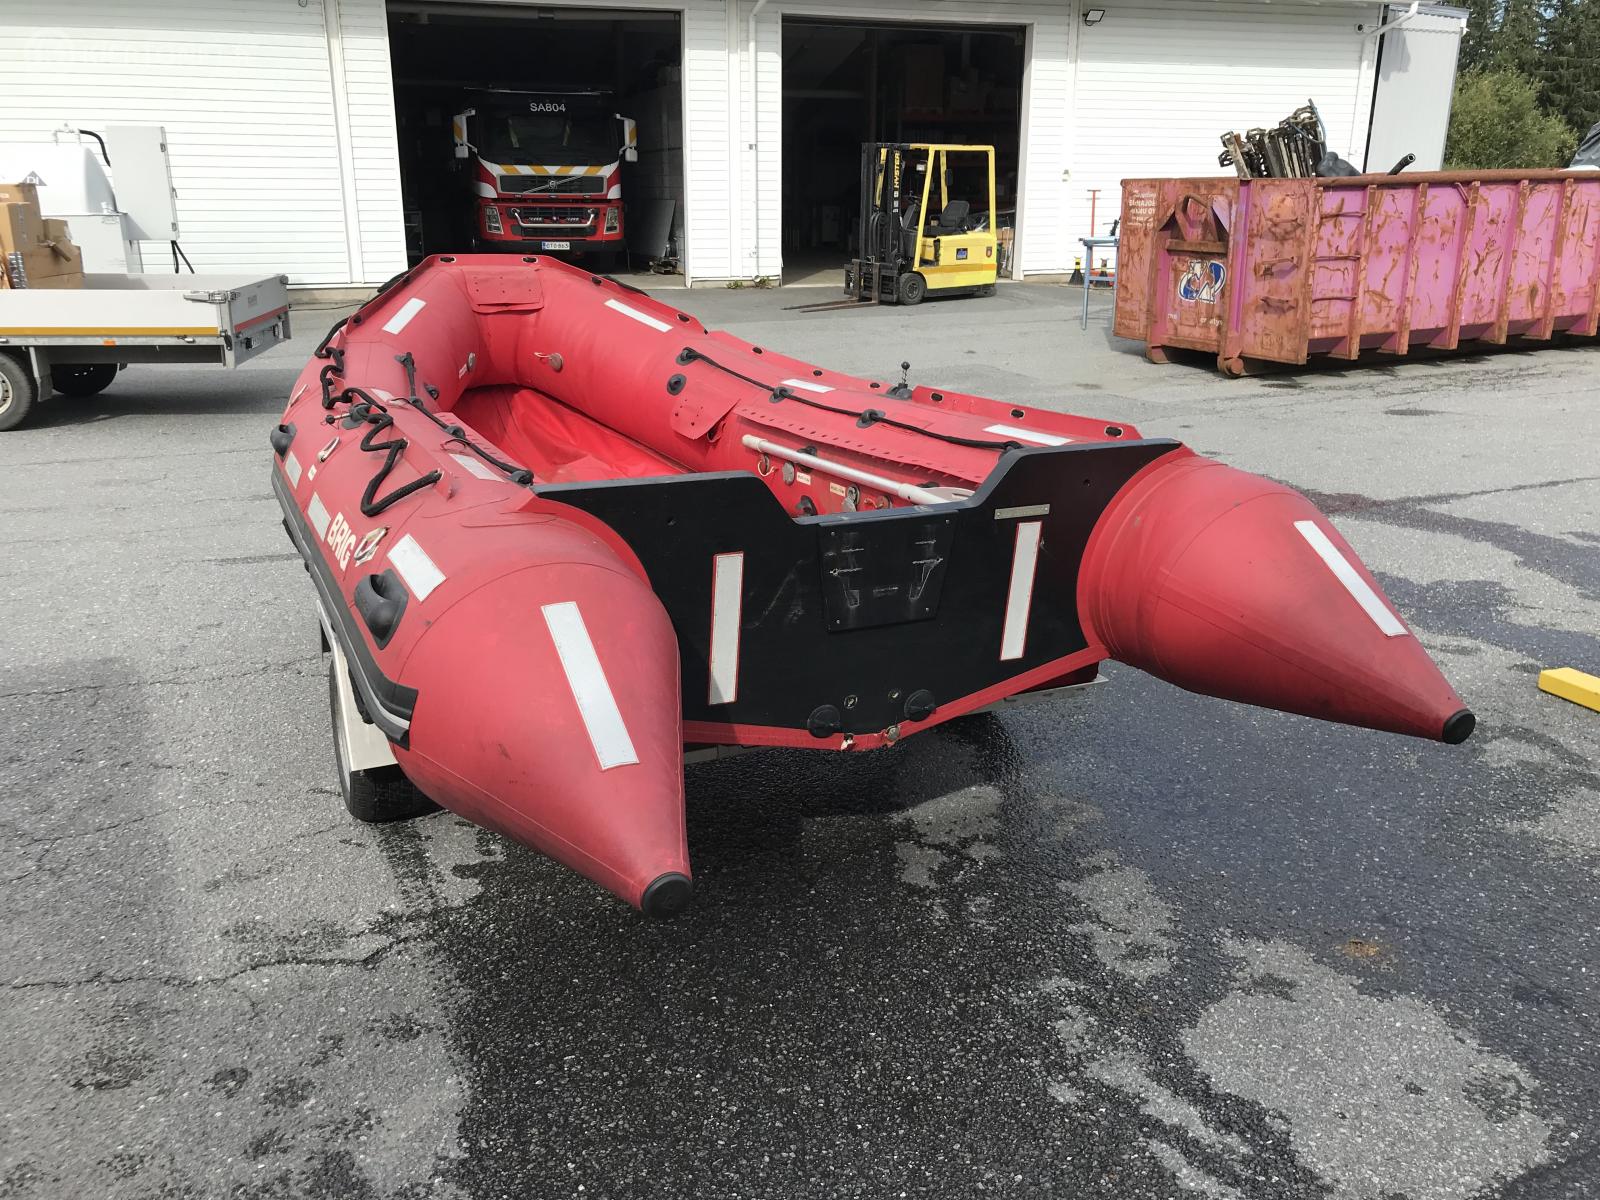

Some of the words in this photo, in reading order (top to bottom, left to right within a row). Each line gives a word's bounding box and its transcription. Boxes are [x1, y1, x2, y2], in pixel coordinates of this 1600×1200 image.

[530, 103, 566, 112] SA804
[893, 151, 901, 188] HYSTER
[327, 512, 357, 571] BRIG
